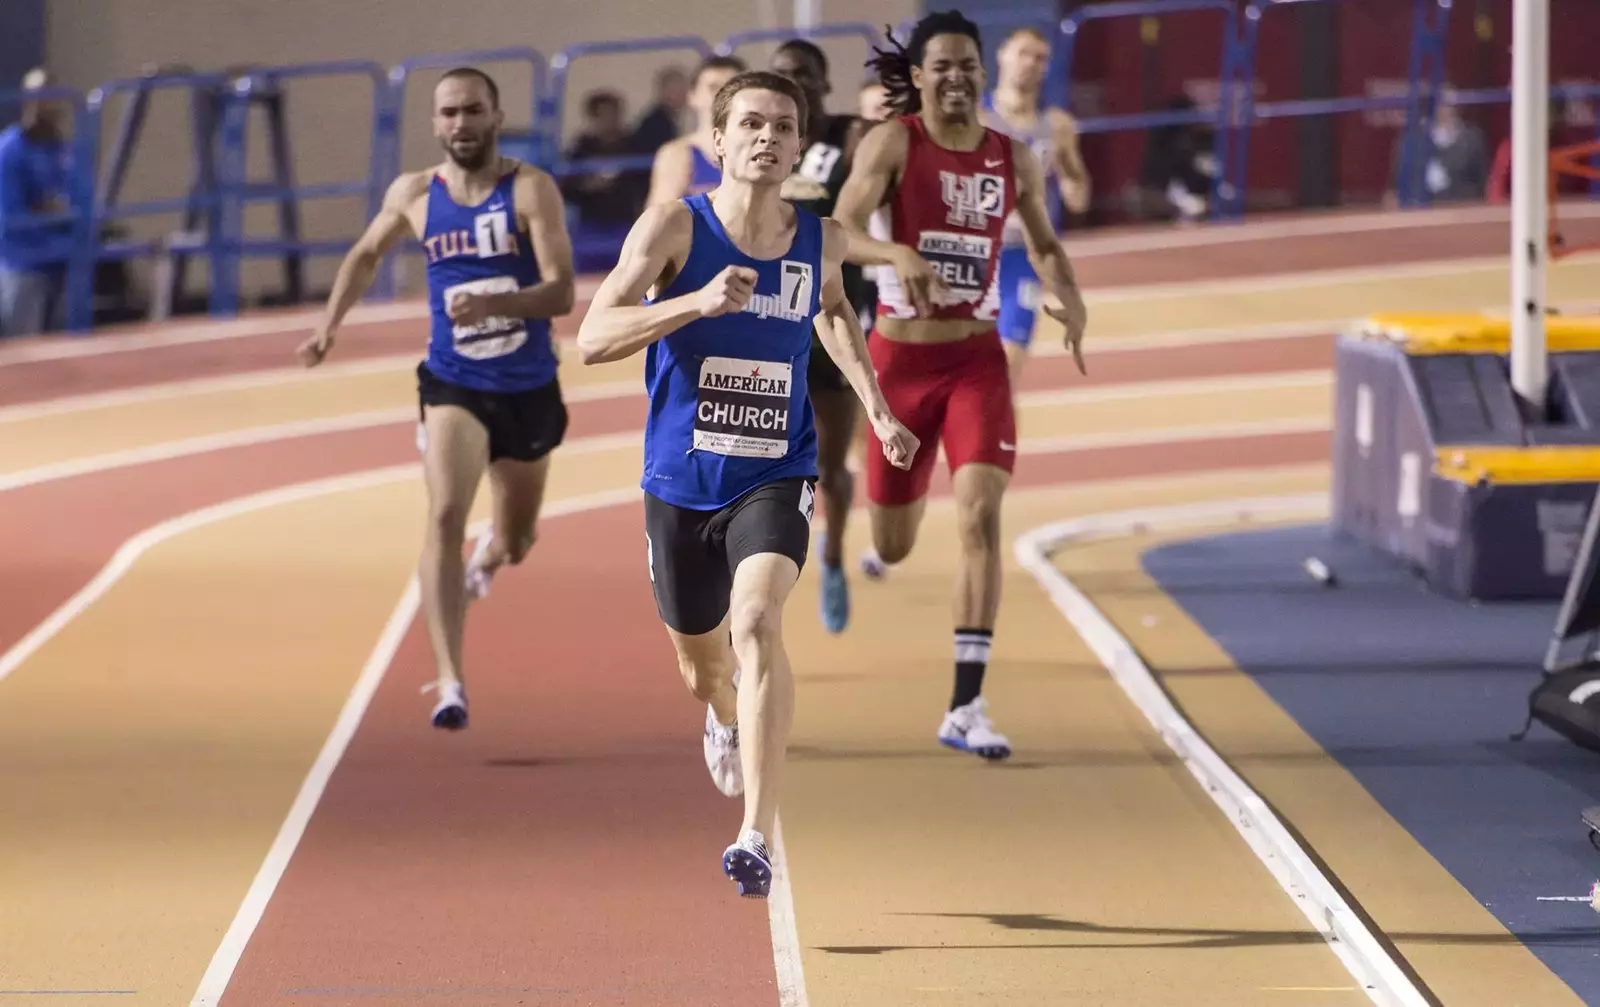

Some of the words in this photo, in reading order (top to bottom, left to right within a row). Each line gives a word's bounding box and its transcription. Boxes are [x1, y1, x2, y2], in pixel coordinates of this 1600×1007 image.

[980, 178, 999, 212] 6
[424, 230, 520, 264] TULA
[482, 218, 498, 252] 1
[785, 264, 809, 310] 7
[703, 373, 787, 395] AMERICAN
[698, 401, 788, 431] CHURCH
